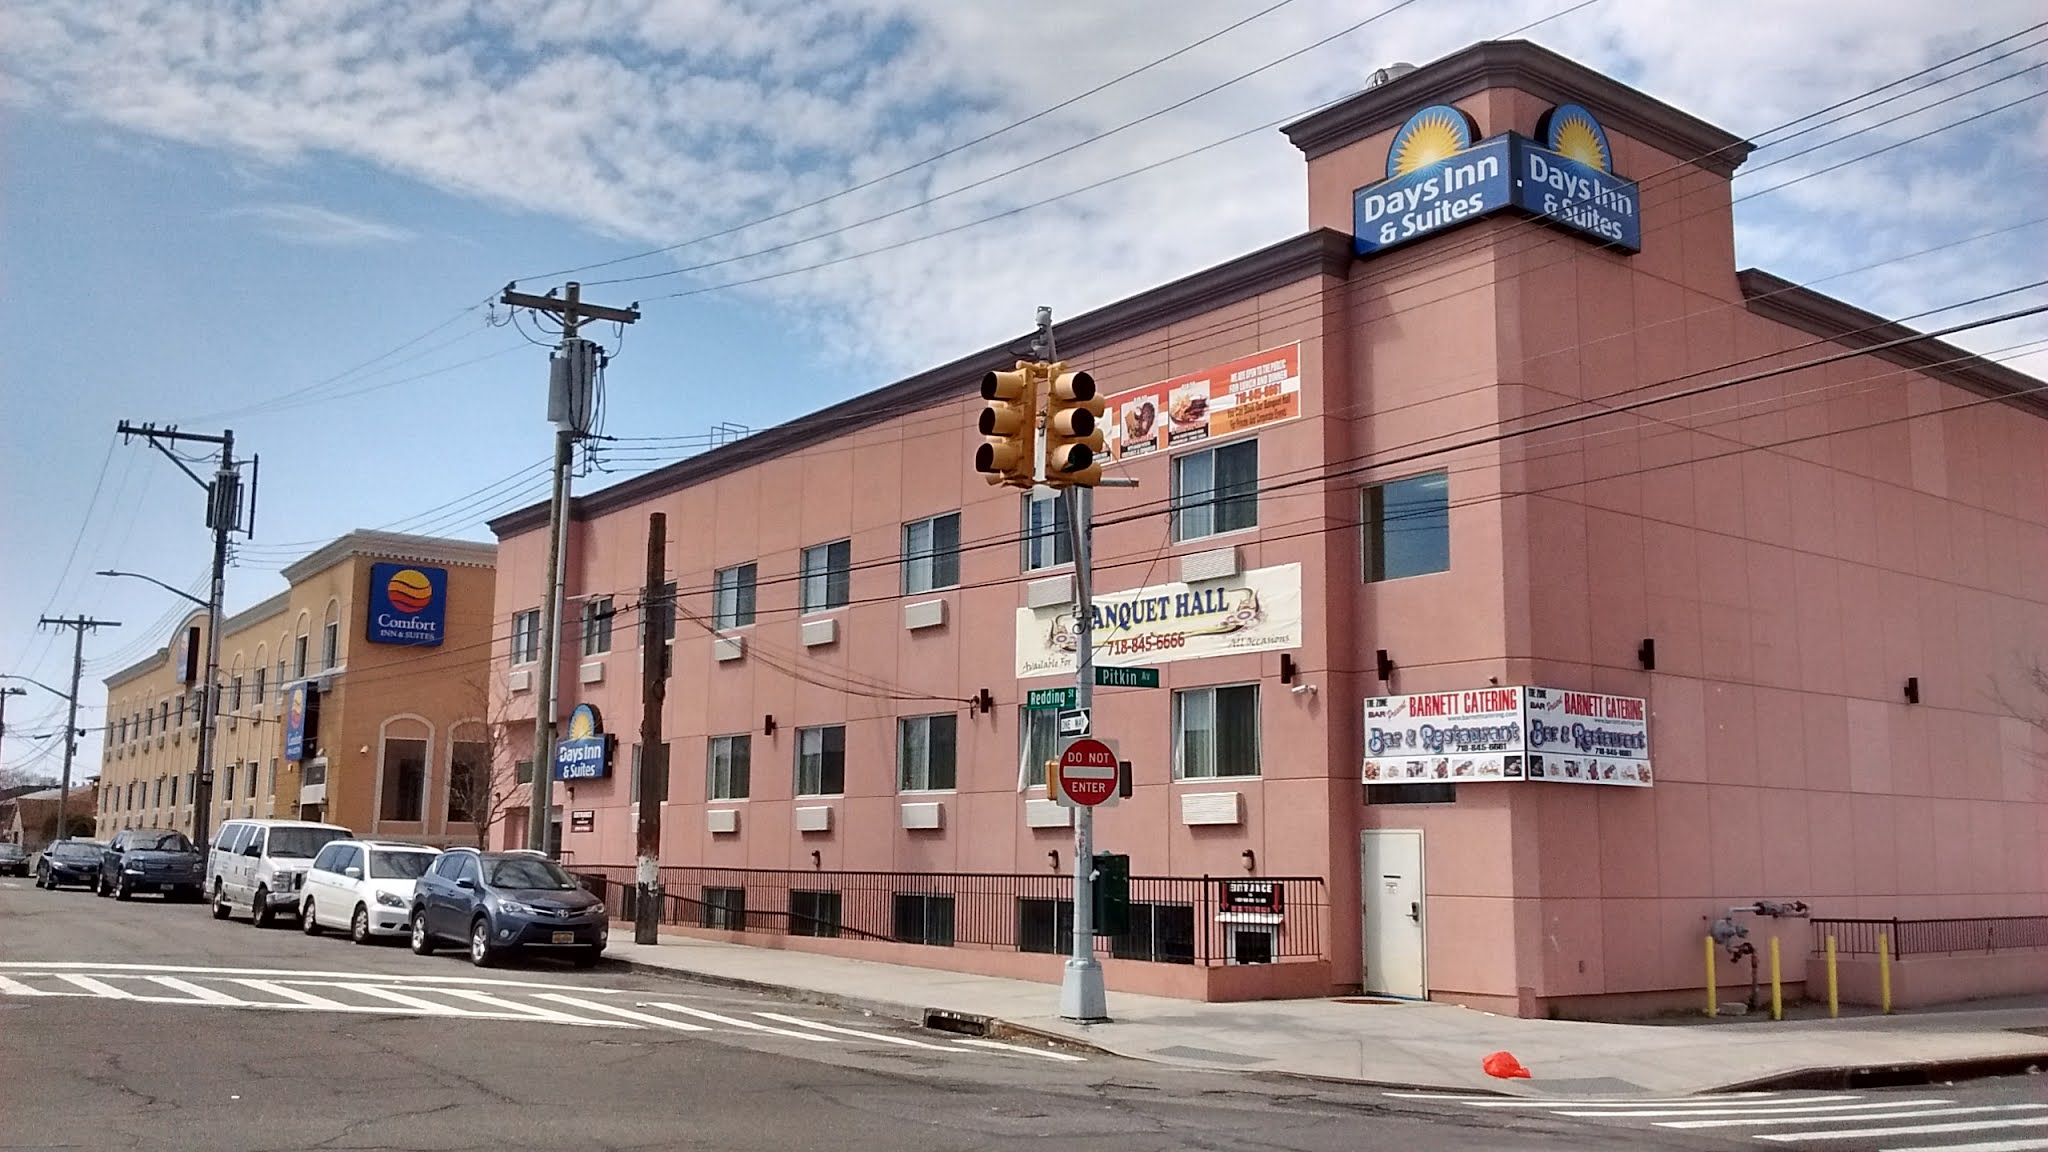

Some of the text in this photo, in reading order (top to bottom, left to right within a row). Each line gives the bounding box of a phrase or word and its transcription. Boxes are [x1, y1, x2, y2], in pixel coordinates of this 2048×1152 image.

[1365, 156, 1498, 223] Days Inn
[1530, 154, 1632, 217] Days Inn
[1379, 193, 1483, 244] & Suites
[1544, 193, 1623, 240] & Suites
[1091, 587, 1230, 631] ANQUET HALL
[378, 613, 436, 631] Comfort
[380, 629, 397, 637] INN
[405, 631, 435, 640] SUITES
[1107, 632, 1185, 656] 718-845-6666
[1103, 669, 1150, 685] Pitkin Av
[1031, 690, 1074, 707] Redding St
[1409, 693, 1459, 717] BARNETT
[1464, 689, 1517, 713] CATERING
[1530, 701, 1545, 710] BAR
[1564, 692, 1603, 717] BARNETT
[1605, 697, 1643, 720] CATERING
[1369, 721, 1520, 755] Bar & Restaurant
[1530, 718, 1559, 748] Bar
[559, 744, 601, 763] Days Inn
[1068, 752, 1109, 763] DO NOT
[563, 763, 595, 778] & Suites
[1072, 782, 1105, 793] ENTER
